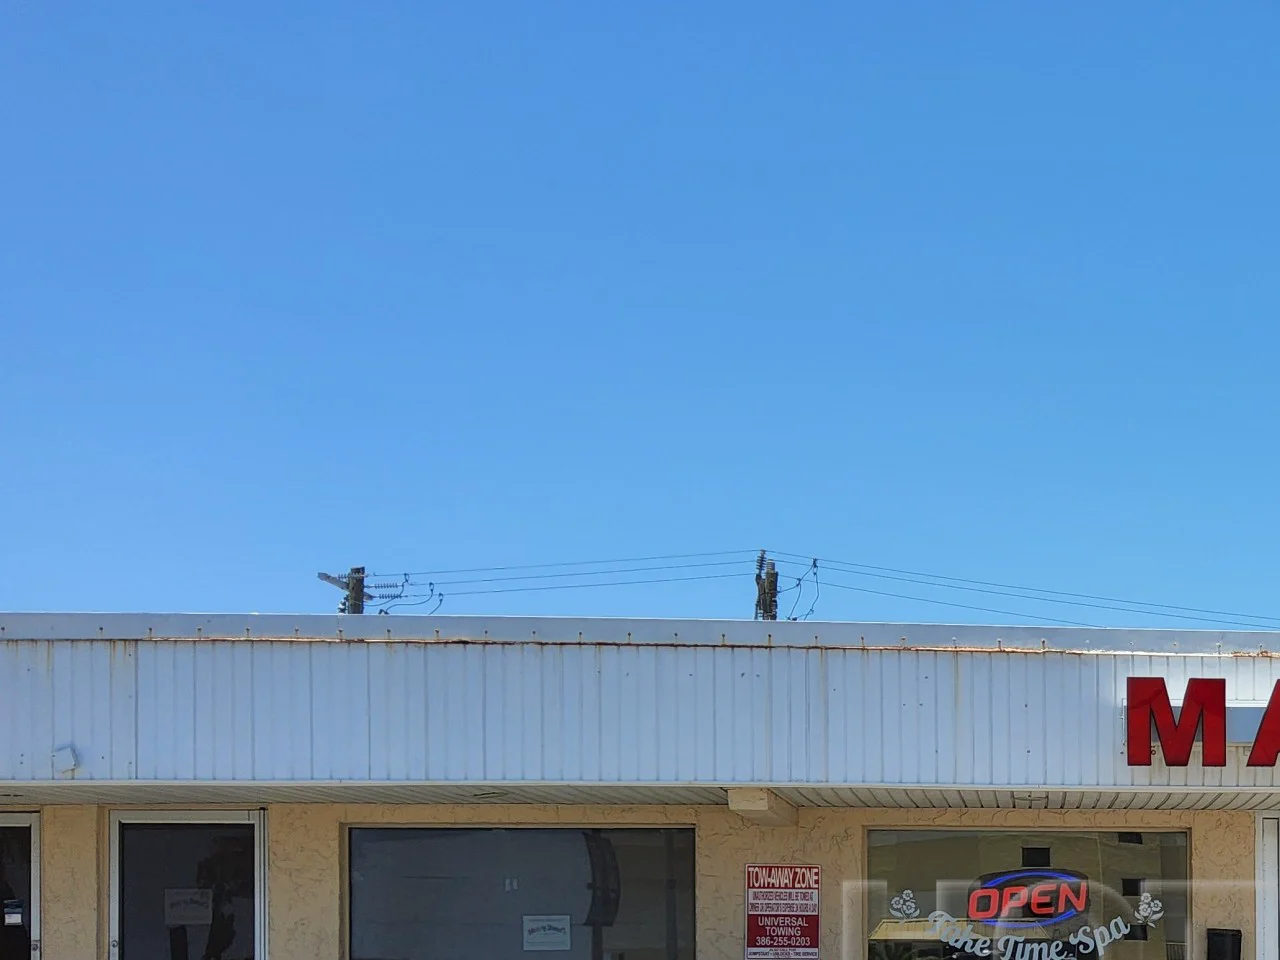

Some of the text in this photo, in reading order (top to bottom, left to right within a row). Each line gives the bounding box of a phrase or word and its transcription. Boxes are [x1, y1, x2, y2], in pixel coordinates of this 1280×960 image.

[748, 866, 819, 888] TOW-AWAY ZONE
[968, 881, 1088, 920] OPEN
[758, 916, 809, 926] UNIVERSAL
[765, 926, 801, 936] TOWING
[926, 910, 991, 957] Take
[1069, 915, 1132, 957] Spa
[755, 936, 811, 946] 386-255-0203
